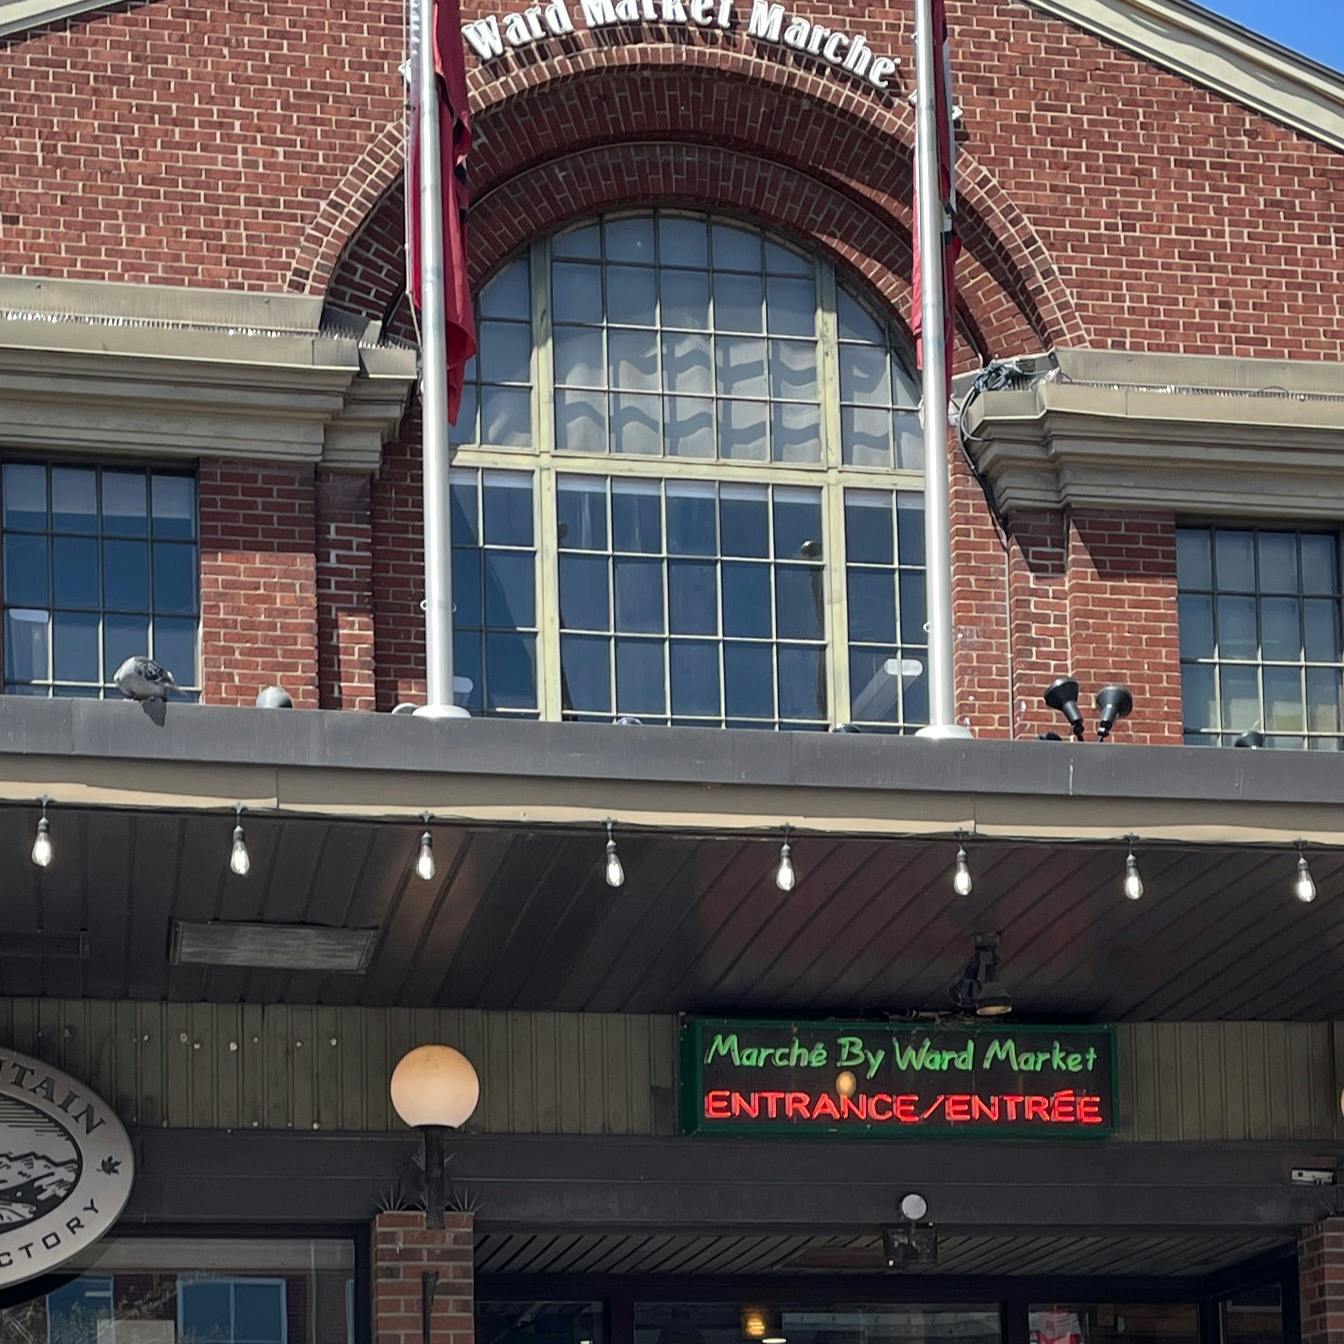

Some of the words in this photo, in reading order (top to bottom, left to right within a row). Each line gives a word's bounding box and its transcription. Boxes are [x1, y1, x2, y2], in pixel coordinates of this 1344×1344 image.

[461, 0, 575, 60] Ward
[704, 1034, 828, 1068] Marché
[835, 1037, 885, 1079] By
[892, 1037, 975, 1072] Ward
[982, 1038, 1098, 1072] Market
